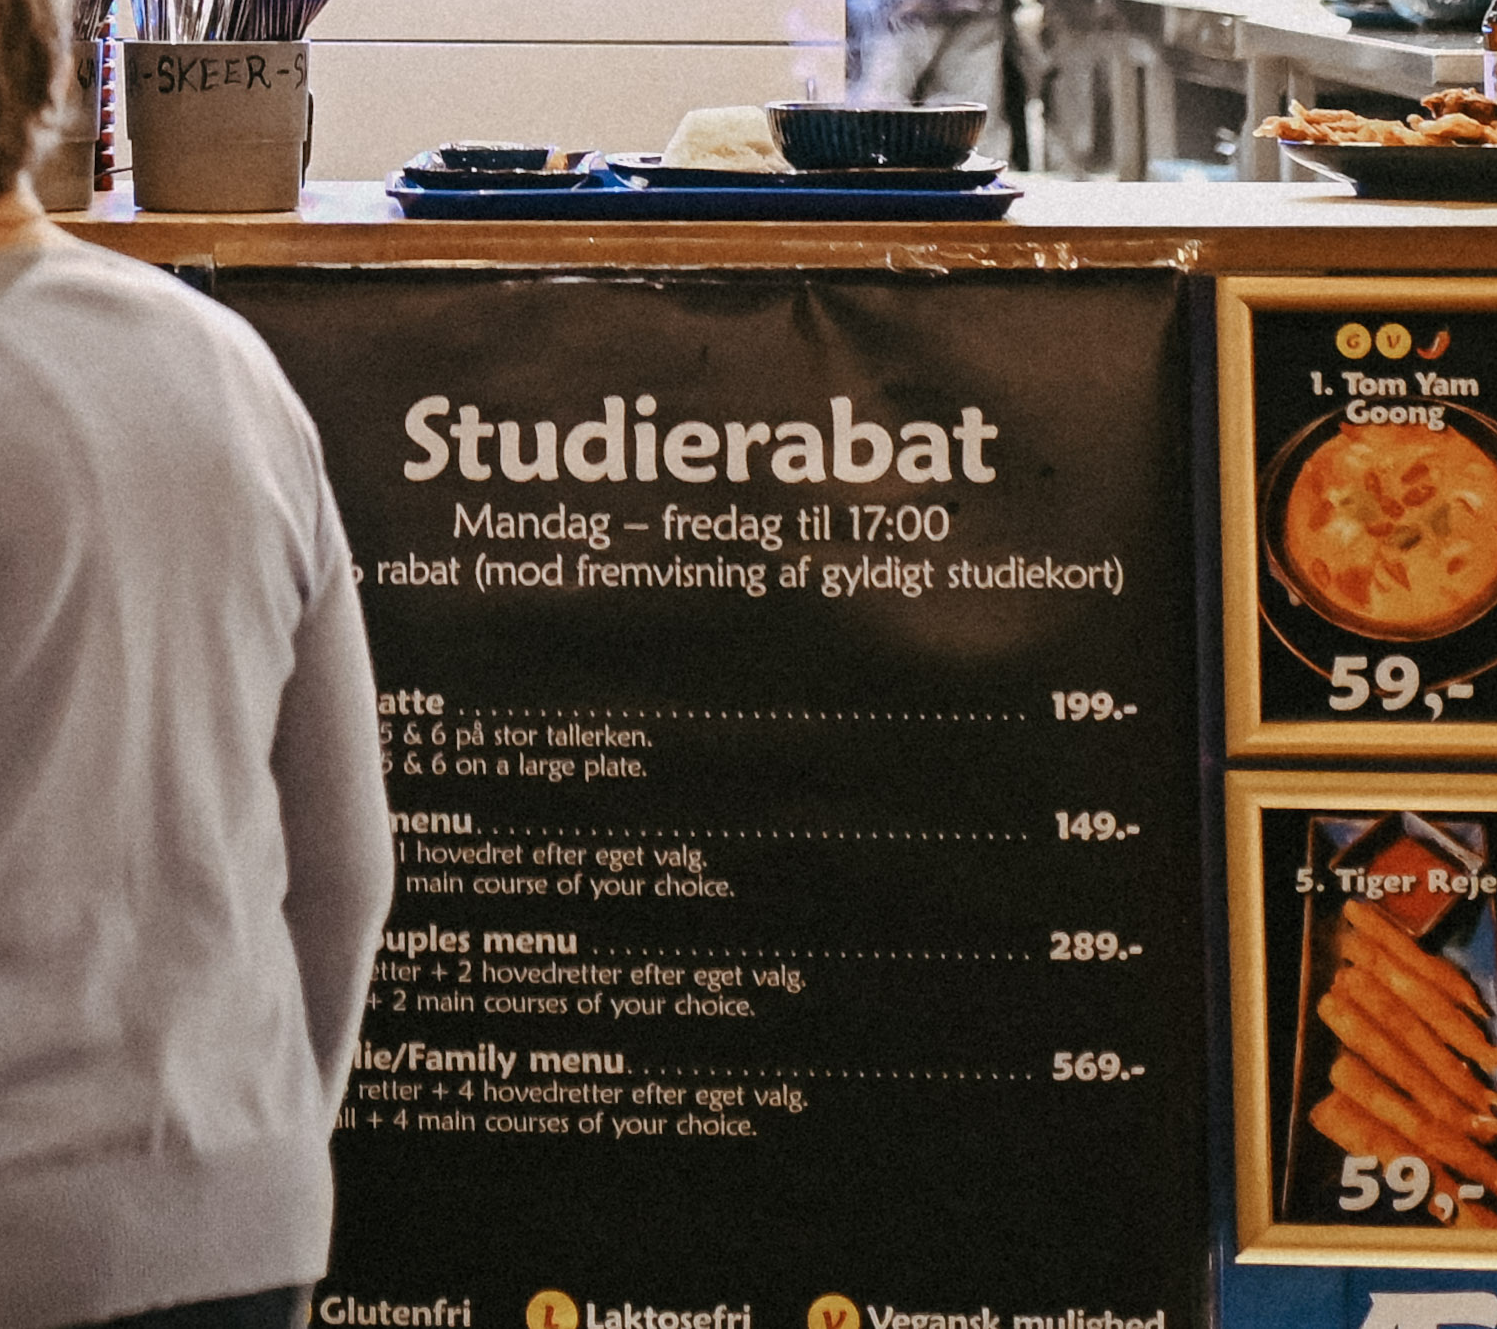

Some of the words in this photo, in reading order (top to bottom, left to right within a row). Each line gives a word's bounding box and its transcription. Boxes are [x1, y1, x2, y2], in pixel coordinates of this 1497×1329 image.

[1310, 371, 1334, 397] 1.
[1342, 371, 1406, 397] Tom
[1415, 371, 1479, 398] Yam
[1345, 399, 1447, 429] Goong
[403, 394, 998, 485] Studierabat
[453, 502, 611, 550] Mandag
[663, 504, 781, 551] fredag
[797, 505, 831, 541] til
[849, 504, 950, 542] 17:00
[378, 552, 461, 586] rabat
[475, 552, 563, 593] (mod
[576, 554, 767, 597] fremvisning
[779, 555, 811, 588] af
[821, 555, 934, 598] gyldigt
[948, 555, 1124, 596] studiekort)
[1328, 656, 1475, 721] 59,-
[1051, 690, 1137, 721] 199.-
[456, 720, 484, 750] på
[494, 724, 539, 746] stor
[547, 723, 652, 748] tallerken.
[456, 755, 486, 776] on
[519, 753, 575, 783] large
[585, 755, 647, 783] plate.
[1055, 810, 1141, 841] 149.-
[418, 842, 523, 865] hovedret
[533, 842, 586, 867] efter
[596, 845, 644, 871] eget
[654, 845, 707, 873] valg.
[406, 871, 464, 894] main
[473, 876, 548, 895] course
[557, 873, 582, 895] of
[592, 877, 646, 901] your
[654, 874, 735, 898] choice.
[1295, 870, 1325, 893] 5.
[1337, 869, 1416, 899] Tiger
[484, 931, 578, 955] menu
[1050, 930, 1144, 962] 289.-
[483, 961, 622, 985] hovedretter
[631, 963, 685, 987] efter
[694, 967, 742, 992] eget
[753, 964, 806, 994] valg.
[417, 991, 474, 1013] main
[484, 995, 568, 1015] courses
[577, 992, 603, 1013] of
[612, 997, 666, 1020] your
[674, 994, 755, 1017] choice.
[530, 1050, 625, 1075] menu
[1052, 1051, 1145, 1083] 569.-
[359, 1081, 422, 1101] retter
[483, 1080, 624, 1104] hovedretter
[632, 1084, 685, 1106] efter
[696, 1086, 744, 1111] eget
[755, 1085, 807, 1113] valg.
[418, 1110, 475, 1132] main
[486, 1114, 569, 1134] courses
[579, 1113, 604, 1134] of
[612, 1116, 668, 1139] your
[677, 1113, 757, 1136] choice.
[1338, 1156, 1486, 1223] 59,-
[324, 1296, 471, 1328] Glutenfri
[586, 1303, 750, 1329] Laktosefri
